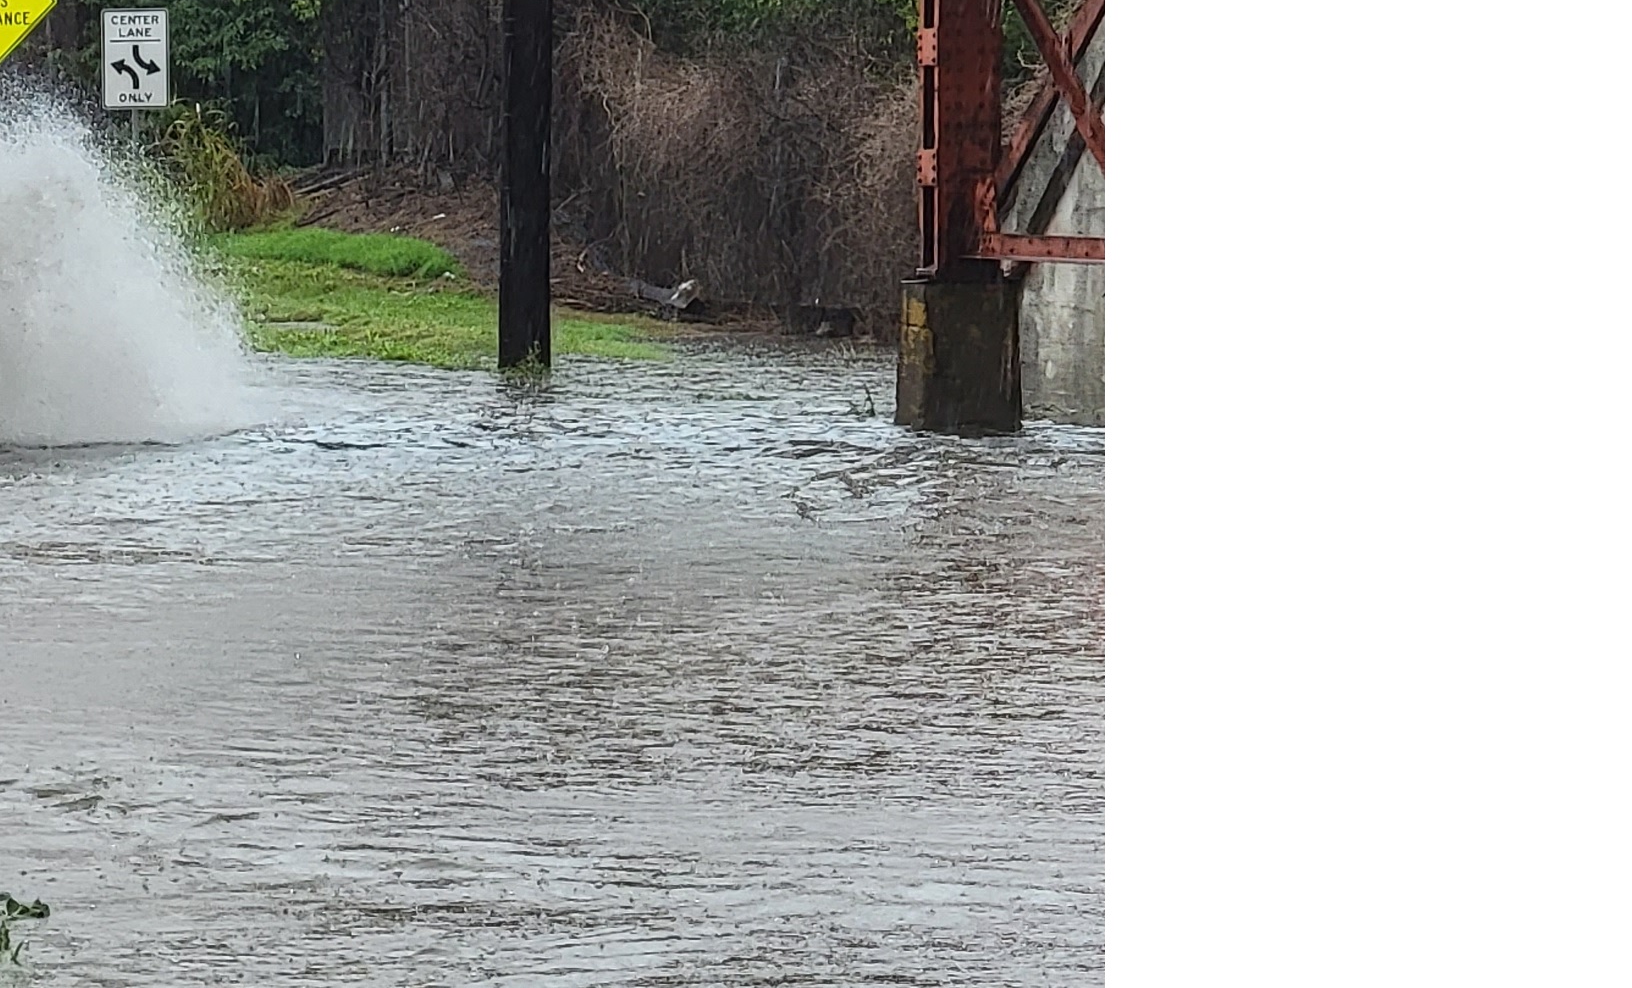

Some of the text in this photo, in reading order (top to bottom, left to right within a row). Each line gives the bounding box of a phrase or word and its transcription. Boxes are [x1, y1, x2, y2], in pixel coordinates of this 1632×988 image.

[111, 15, 159, 25] CENTER
[118, 28, 152, 38] LANE
[119, 92, 152, 103] ONLY
